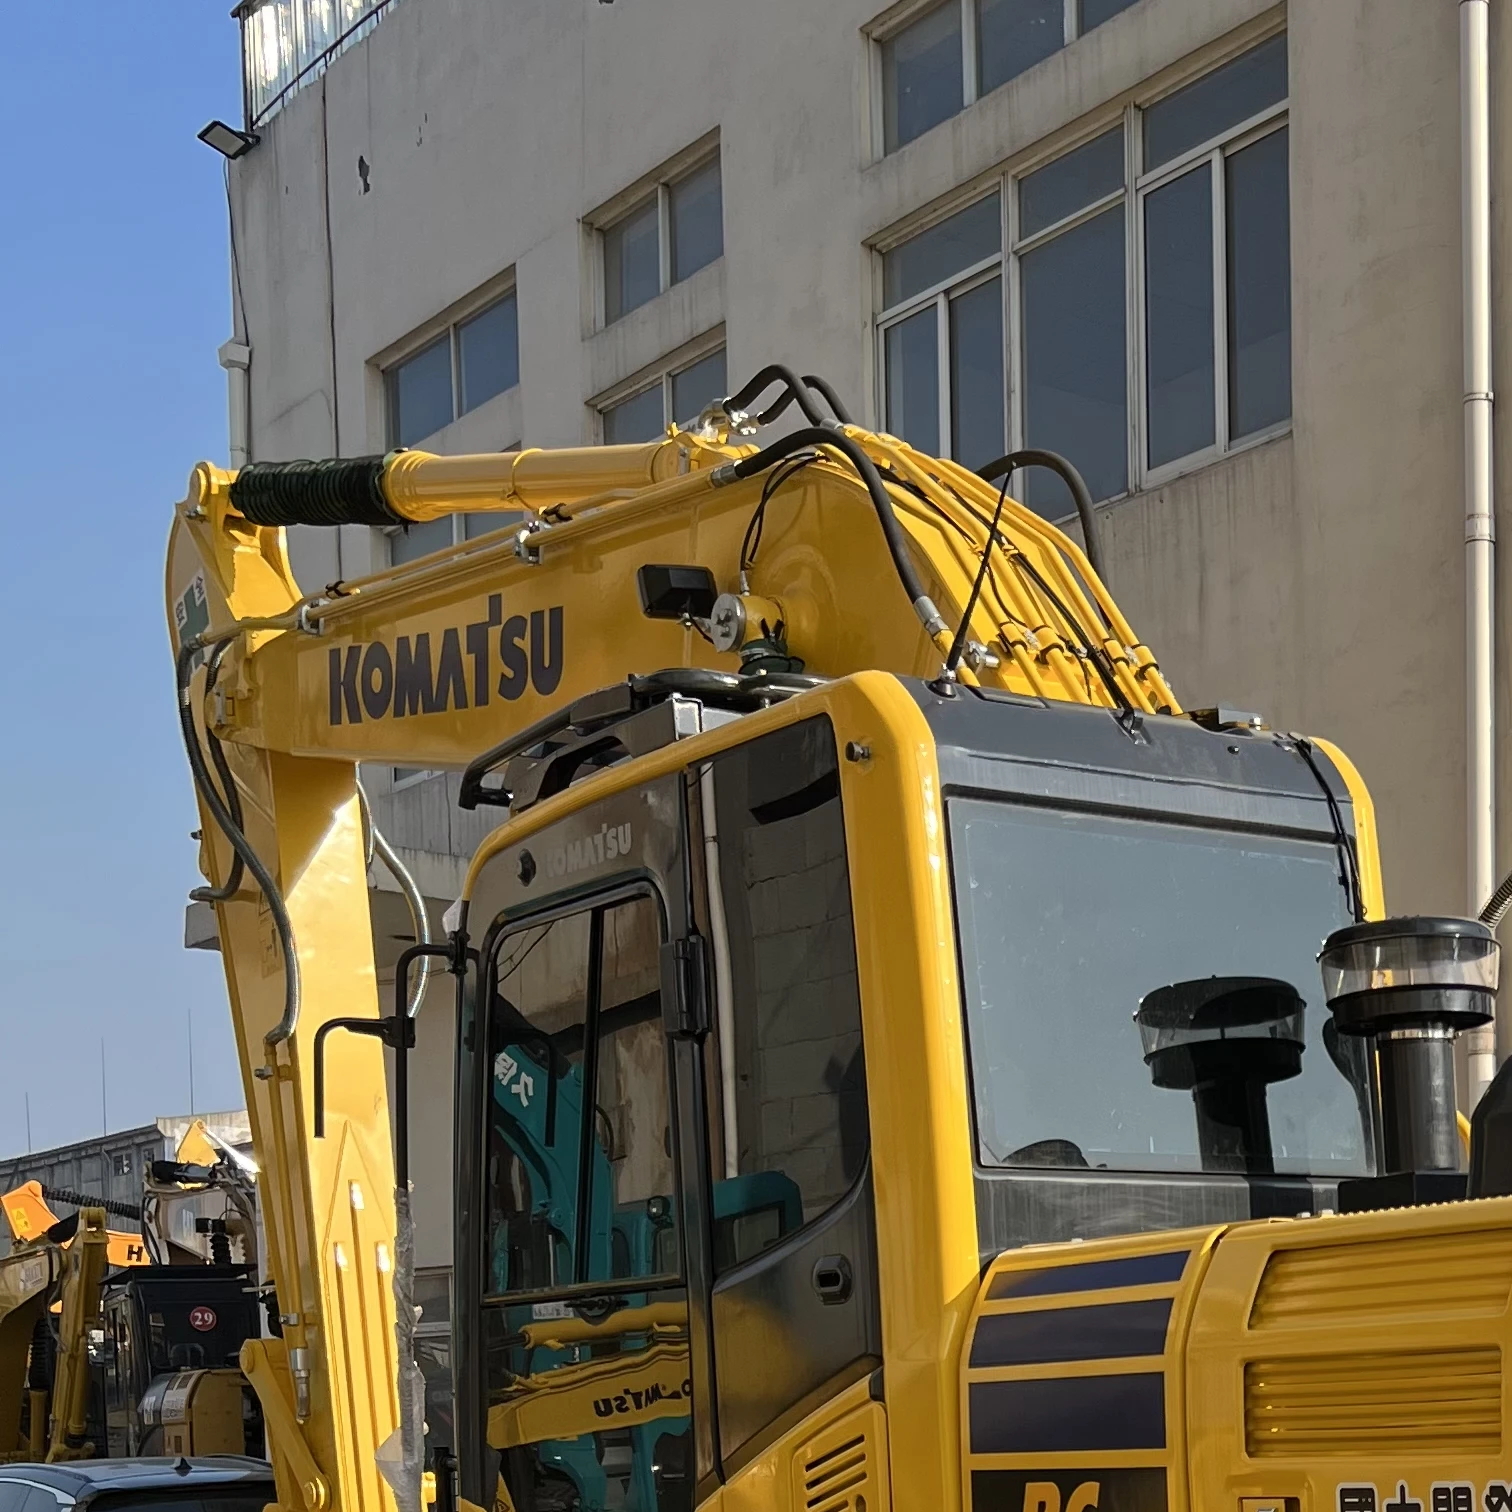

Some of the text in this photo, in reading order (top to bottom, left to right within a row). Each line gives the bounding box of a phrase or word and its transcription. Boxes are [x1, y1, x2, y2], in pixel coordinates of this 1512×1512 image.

[329, 593, 564, 726] KOMATSU
[544, 822, 632, 878] KOMATSU
[193, 1310, 214, 1326] 29
